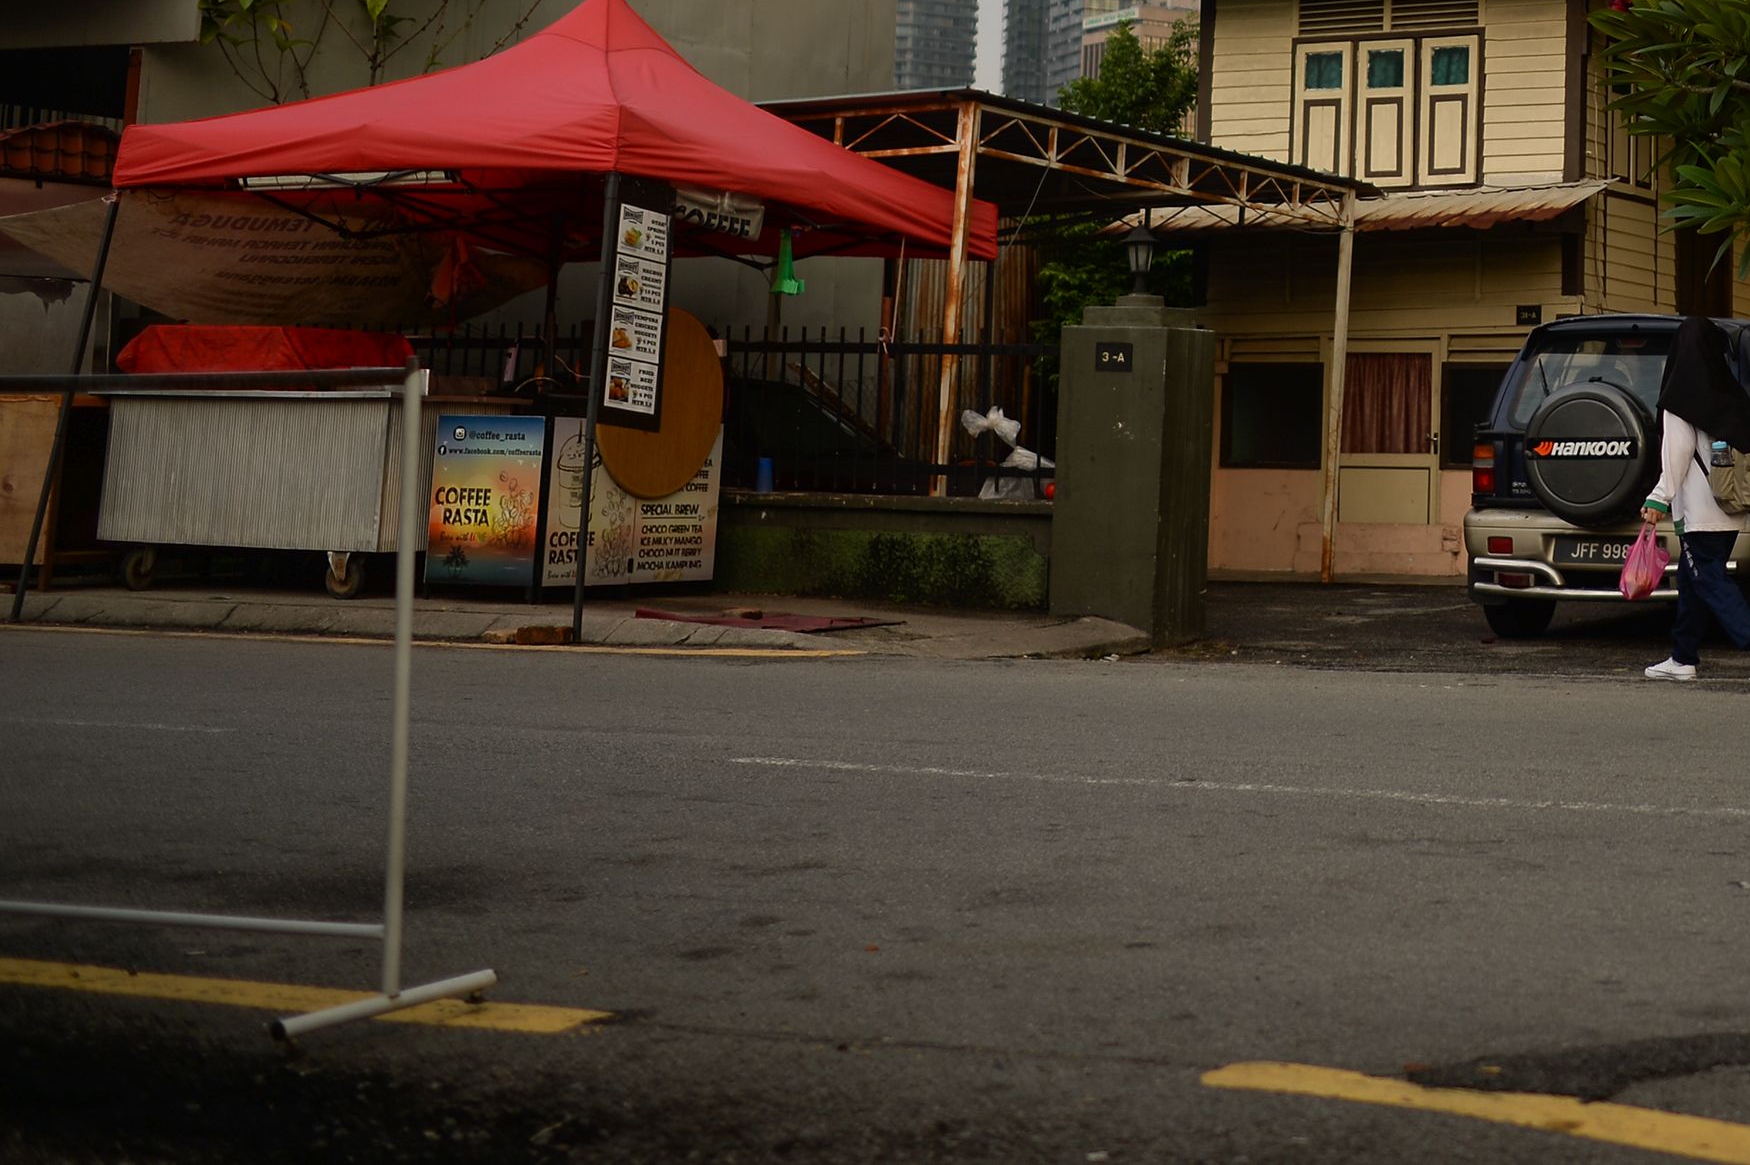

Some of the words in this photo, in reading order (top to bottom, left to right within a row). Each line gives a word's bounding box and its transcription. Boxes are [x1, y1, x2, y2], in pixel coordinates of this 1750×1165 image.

[469, 430, 526, 442] @coffee_rasta
[449, 447, 542, 456] www.facebook.com/coffeerasta
[435, 486, 491, 505] COFFEE
[641, 504, 672, 515] SPECIAL
[675, 504, 699, 515] BREW
[443, 508, 489, 527] RASTA
[642, 525, 667, 534] CHOCO
[669, 525, 690, 533] GREEN
[692, 525, 702, 533] TEA
[550, 531, 595, 547] COFE
[641, 537, 651, 546] ICE
[652, 537, 673, 545] MILKY
[674, 536, 702, 545] MANGO
[639, 548, 664, 558] CHOCO
[666, 548, 680, 557] NUT
[681, 548, 702, 557] BERRY
[1571, 543, 1599, 558] JFF
[549, 549, 578, 564] RAST
[637, 561, 664, 571] MOCHA
[666, 560, 702, 570] KAMPUNG
